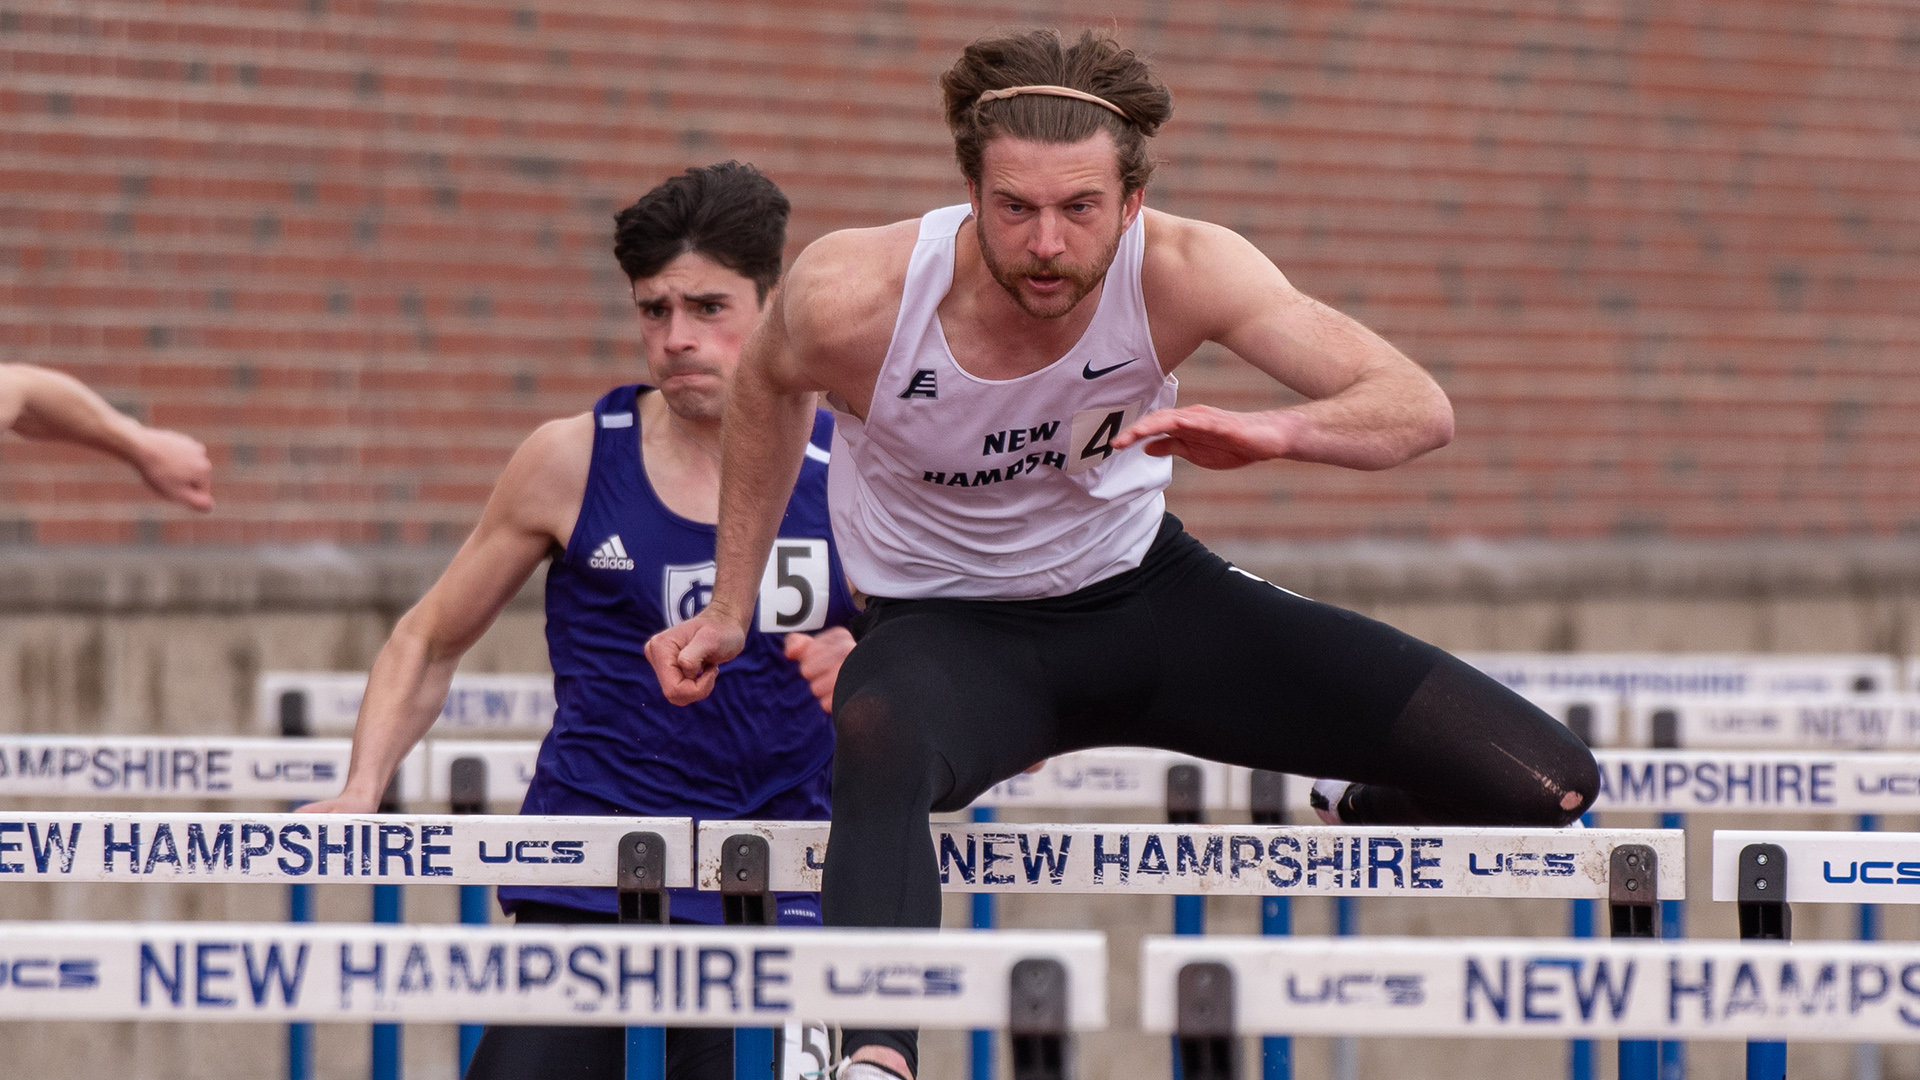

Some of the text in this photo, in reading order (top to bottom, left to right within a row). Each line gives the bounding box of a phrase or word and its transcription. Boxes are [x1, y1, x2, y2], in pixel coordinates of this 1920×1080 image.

[982, 420, 1061, 456] NEW
[1080, 410, 1125, 461] 4
[922, 450, 1068, 487] HAMPSH
[589, 556, 635, 571] adidas
[776, 546, 815, 627] 5
[444, 689, 517, 727] EW
[253, 760, 338, 783] UCS
[1597, 762, 1920, 805] AMPSHIRE UC
[0, 822, 586, 878] EW HAMPSHIRE UCS
[940, 832, 1577, 890] NEW HAMPSHIRE UCS
[0, 941, 965, 1014] CS NEW HAMPSHIRE UCS
[1286, 957, 1920, 1028] UCS NEW HAMPS
